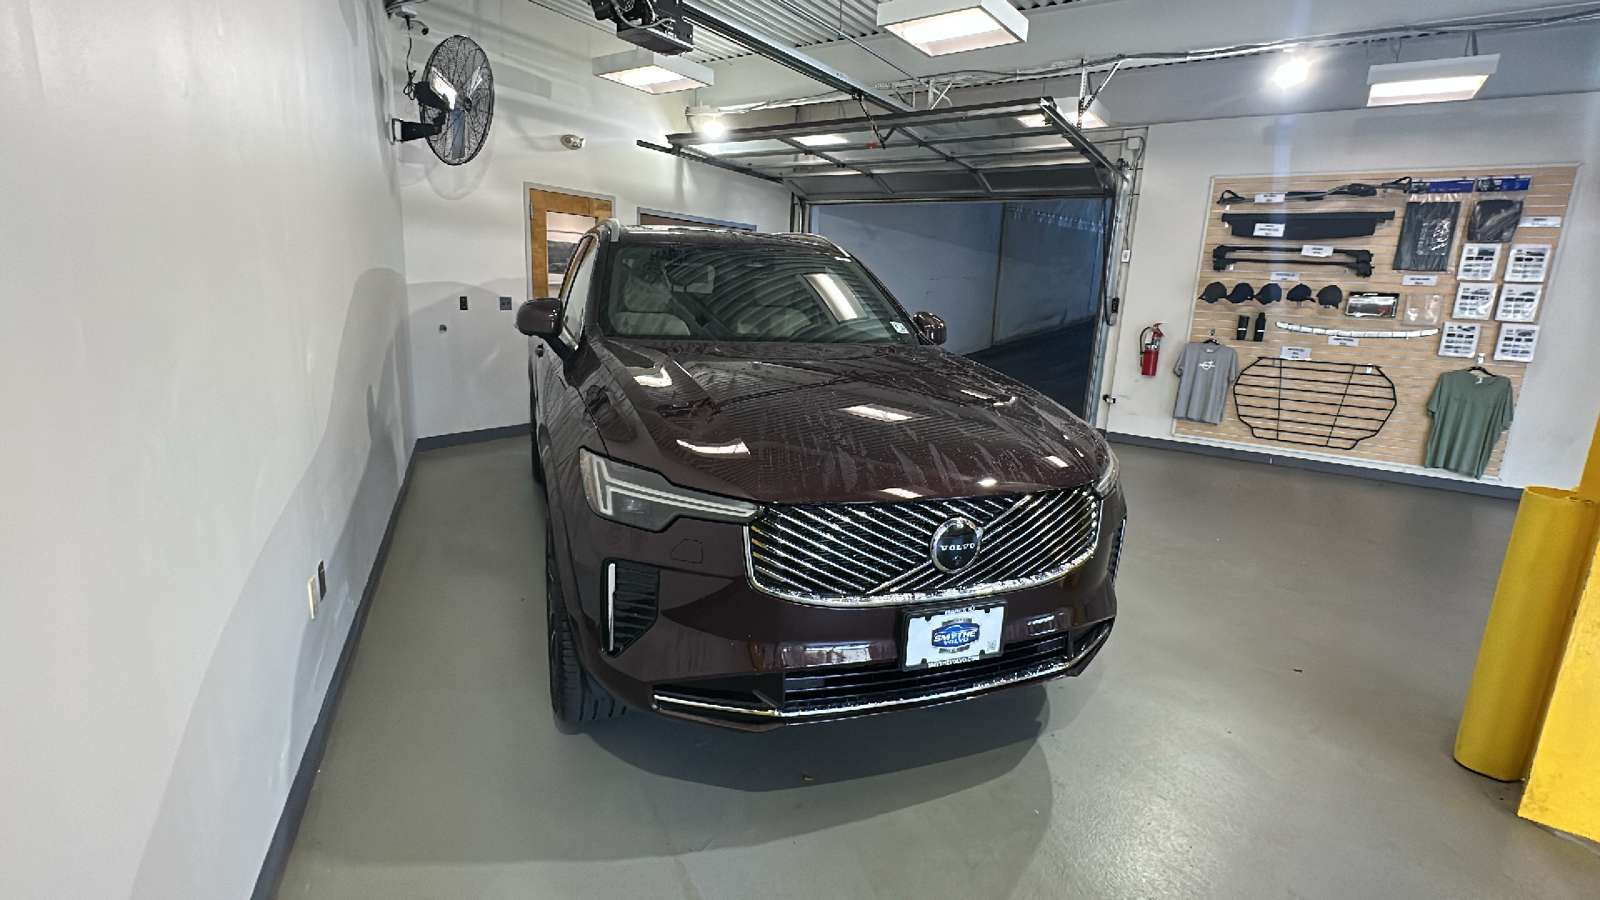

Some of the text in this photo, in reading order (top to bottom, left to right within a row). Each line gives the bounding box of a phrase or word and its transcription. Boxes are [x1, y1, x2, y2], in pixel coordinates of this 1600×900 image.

[940, 543, 976, 551] VOLVO
[934, 629, 976, 642] SMYTHE
[943, 636, 969, 645] VOLVO
